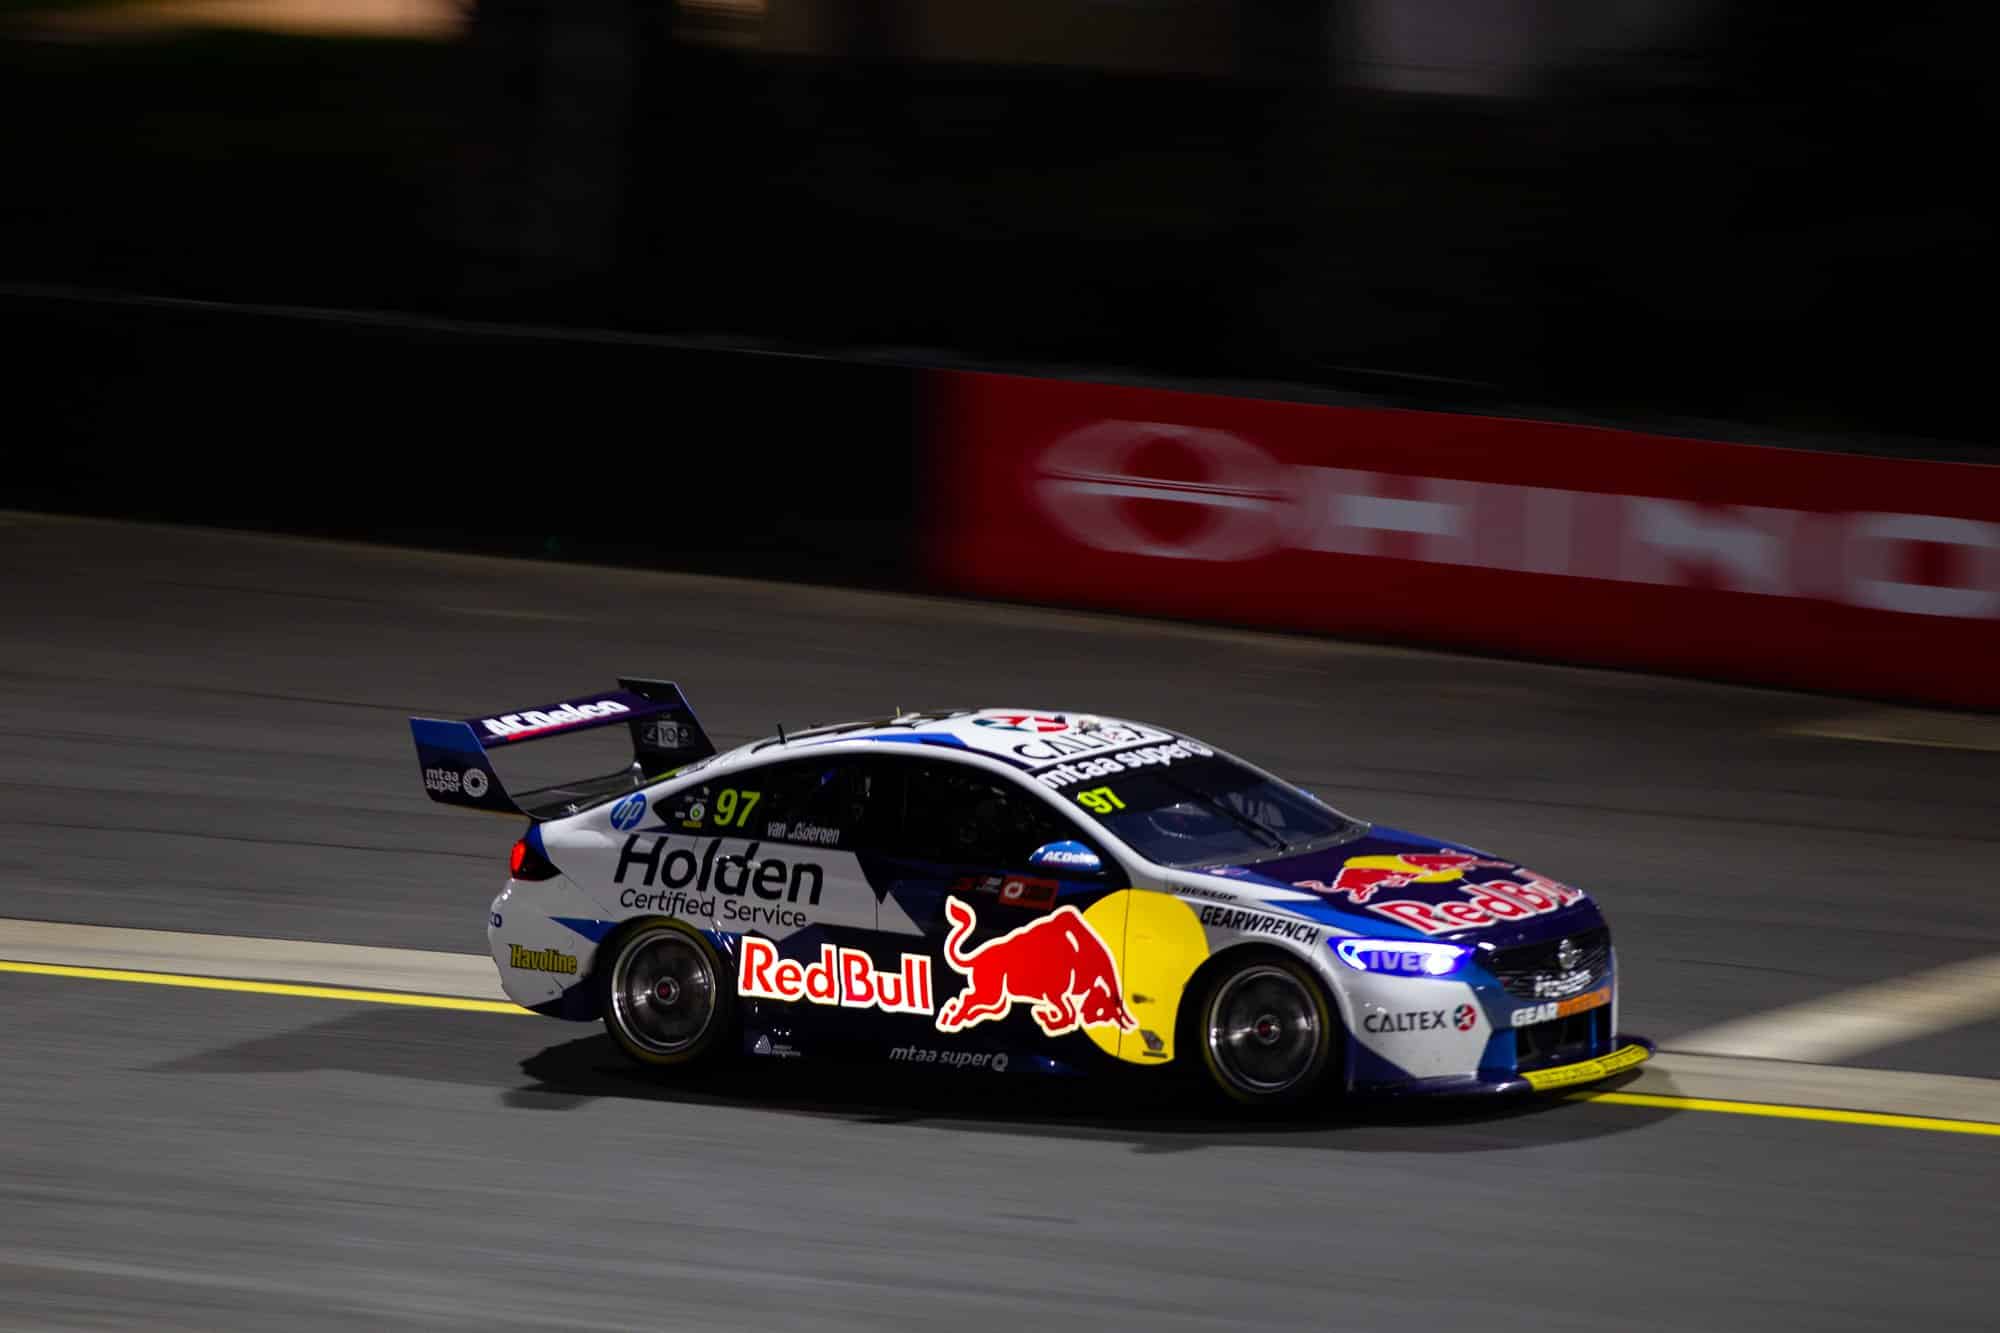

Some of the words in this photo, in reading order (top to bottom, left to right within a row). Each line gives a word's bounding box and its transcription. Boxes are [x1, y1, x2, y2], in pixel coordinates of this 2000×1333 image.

[481, 700, 631, 737] ACDelco
[1013, 724, 1146, 760] CALTX
[426, 768, 459, 782] mtaa
[426, 780, 461, 792] super
[1036, 758, 1125, 789] mtaa
[611, 793, 645, 831] hp
[714, 788, 760, 828] 97
[1078, 786, 1126, 814] 97
[767, 820, 786, 839] van
[614, 833, 823, 906] Holden
[619, 888, 716, 918] Certified
[722, 899, 807, 928] Service
[1200, 905, 1321, 945] GEARWRENCH
[510, 944, 577, 974] Havoline
[1370, 951, 1452, 974] IVE
[1363, 1009, 1447, 1033] CALTEX
[889, 1044, 937, 1062] mtaa
[939, 1050, 992, 1067] super
